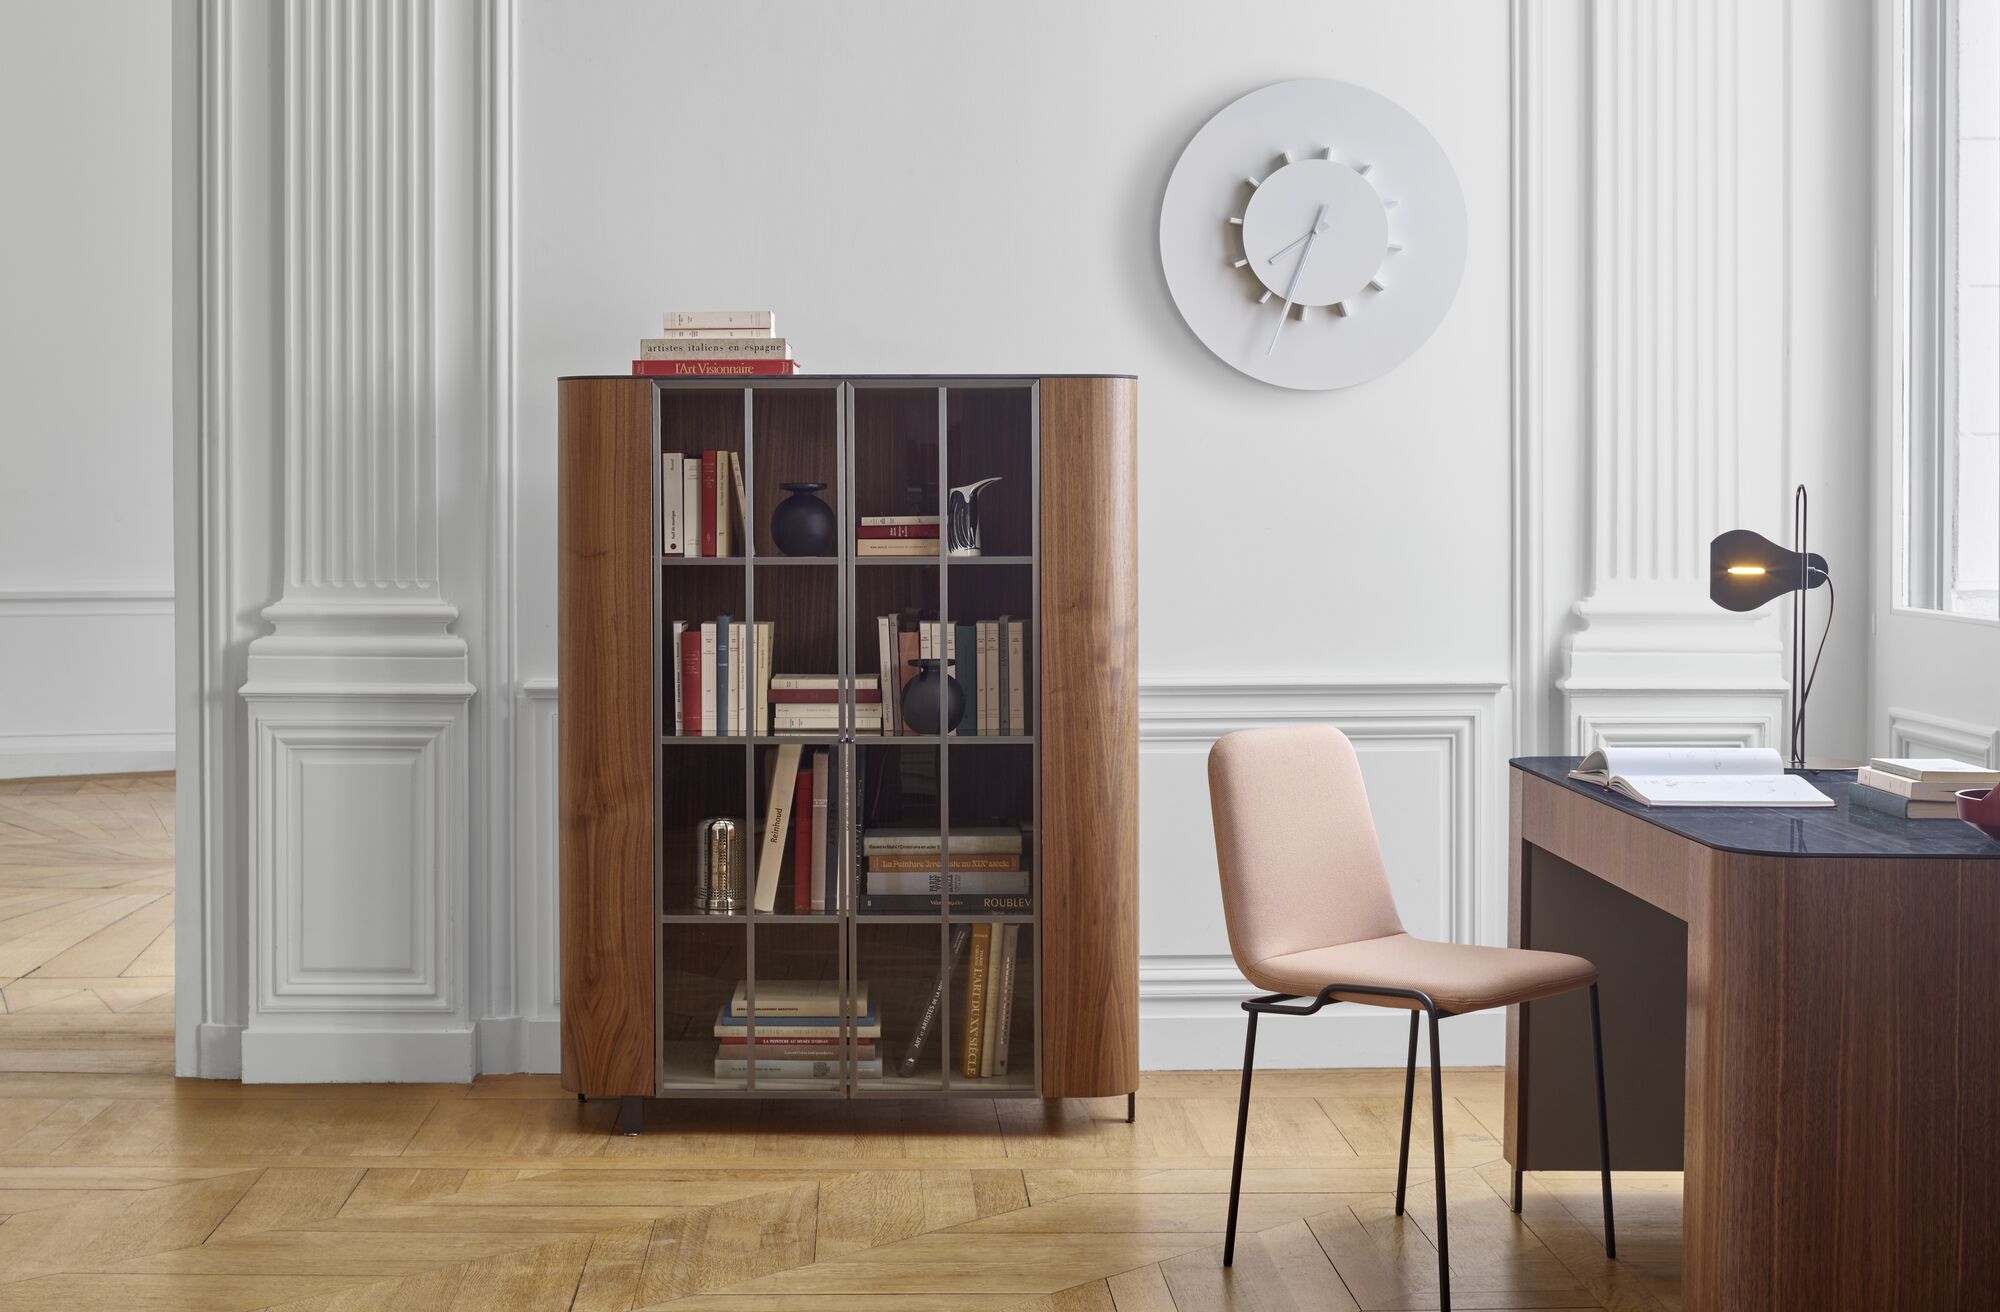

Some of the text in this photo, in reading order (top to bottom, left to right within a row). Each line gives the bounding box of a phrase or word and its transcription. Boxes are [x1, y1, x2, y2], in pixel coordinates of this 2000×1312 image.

[648, 344, 683, 352] artistes
[688, 343, 724, 352] italiens
[744, 345, 782, 354] espagne
[698, 362, 755, 374] Visionnaire
[770, 808, 783, 844] Reinhoud
[882, 860, 893, 868] La
[894, 860, 924, 868] Peinture
[984, 898, 1032, 908] ROUBLEV
[972, 968, 983, 999] L'ART
[970, 1000, 980, 1016] DU
[914, 1036, 922, 1048] ART
[922, 1005, 934, 1030] ARTISTES
